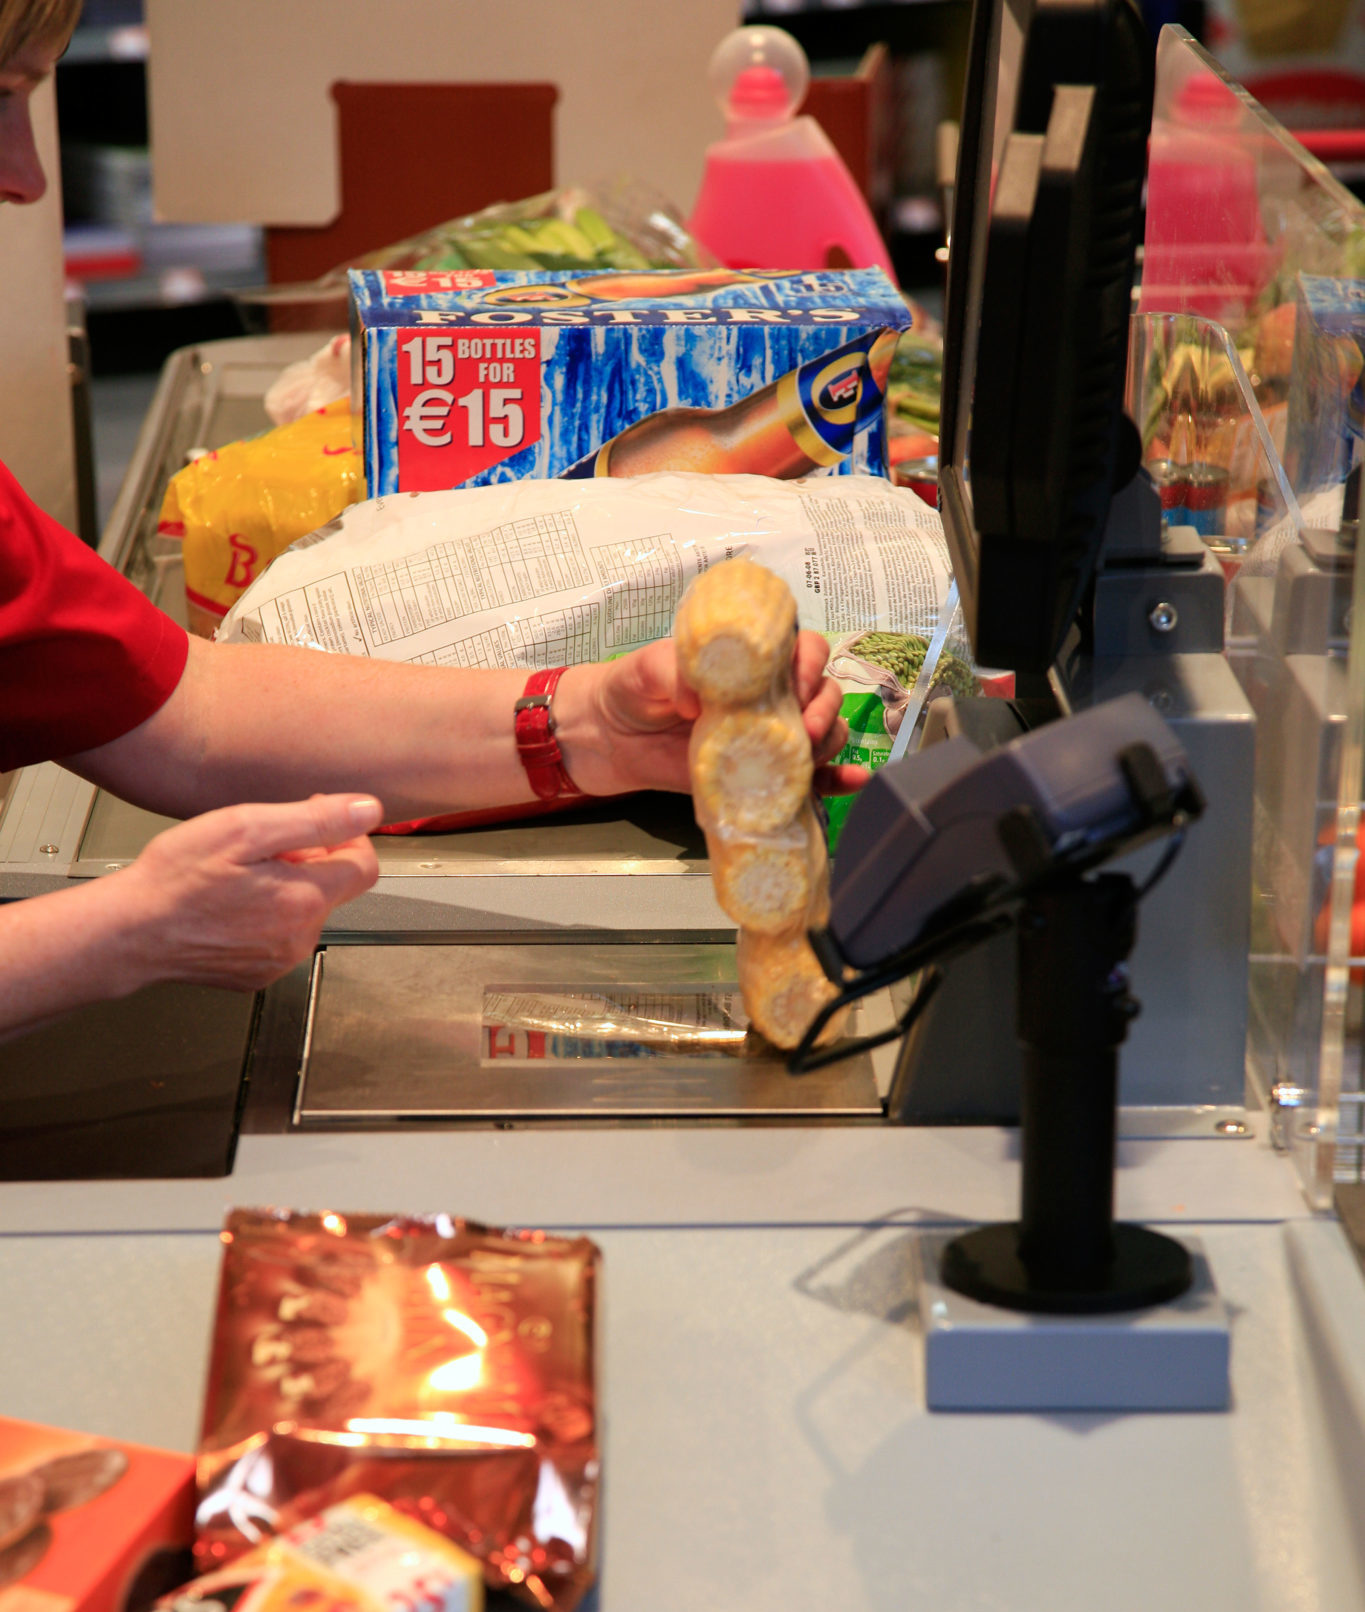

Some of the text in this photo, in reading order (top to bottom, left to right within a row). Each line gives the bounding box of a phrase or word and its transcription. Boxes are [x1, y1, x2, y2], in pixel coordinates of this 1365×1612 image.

[416, 307, 860, 326] FOSTER'S
[402, 336, 536, 386] 15 BOTTLES
[478, 364, 515, 384] FOR
[403, 389, 524, 448] €15
